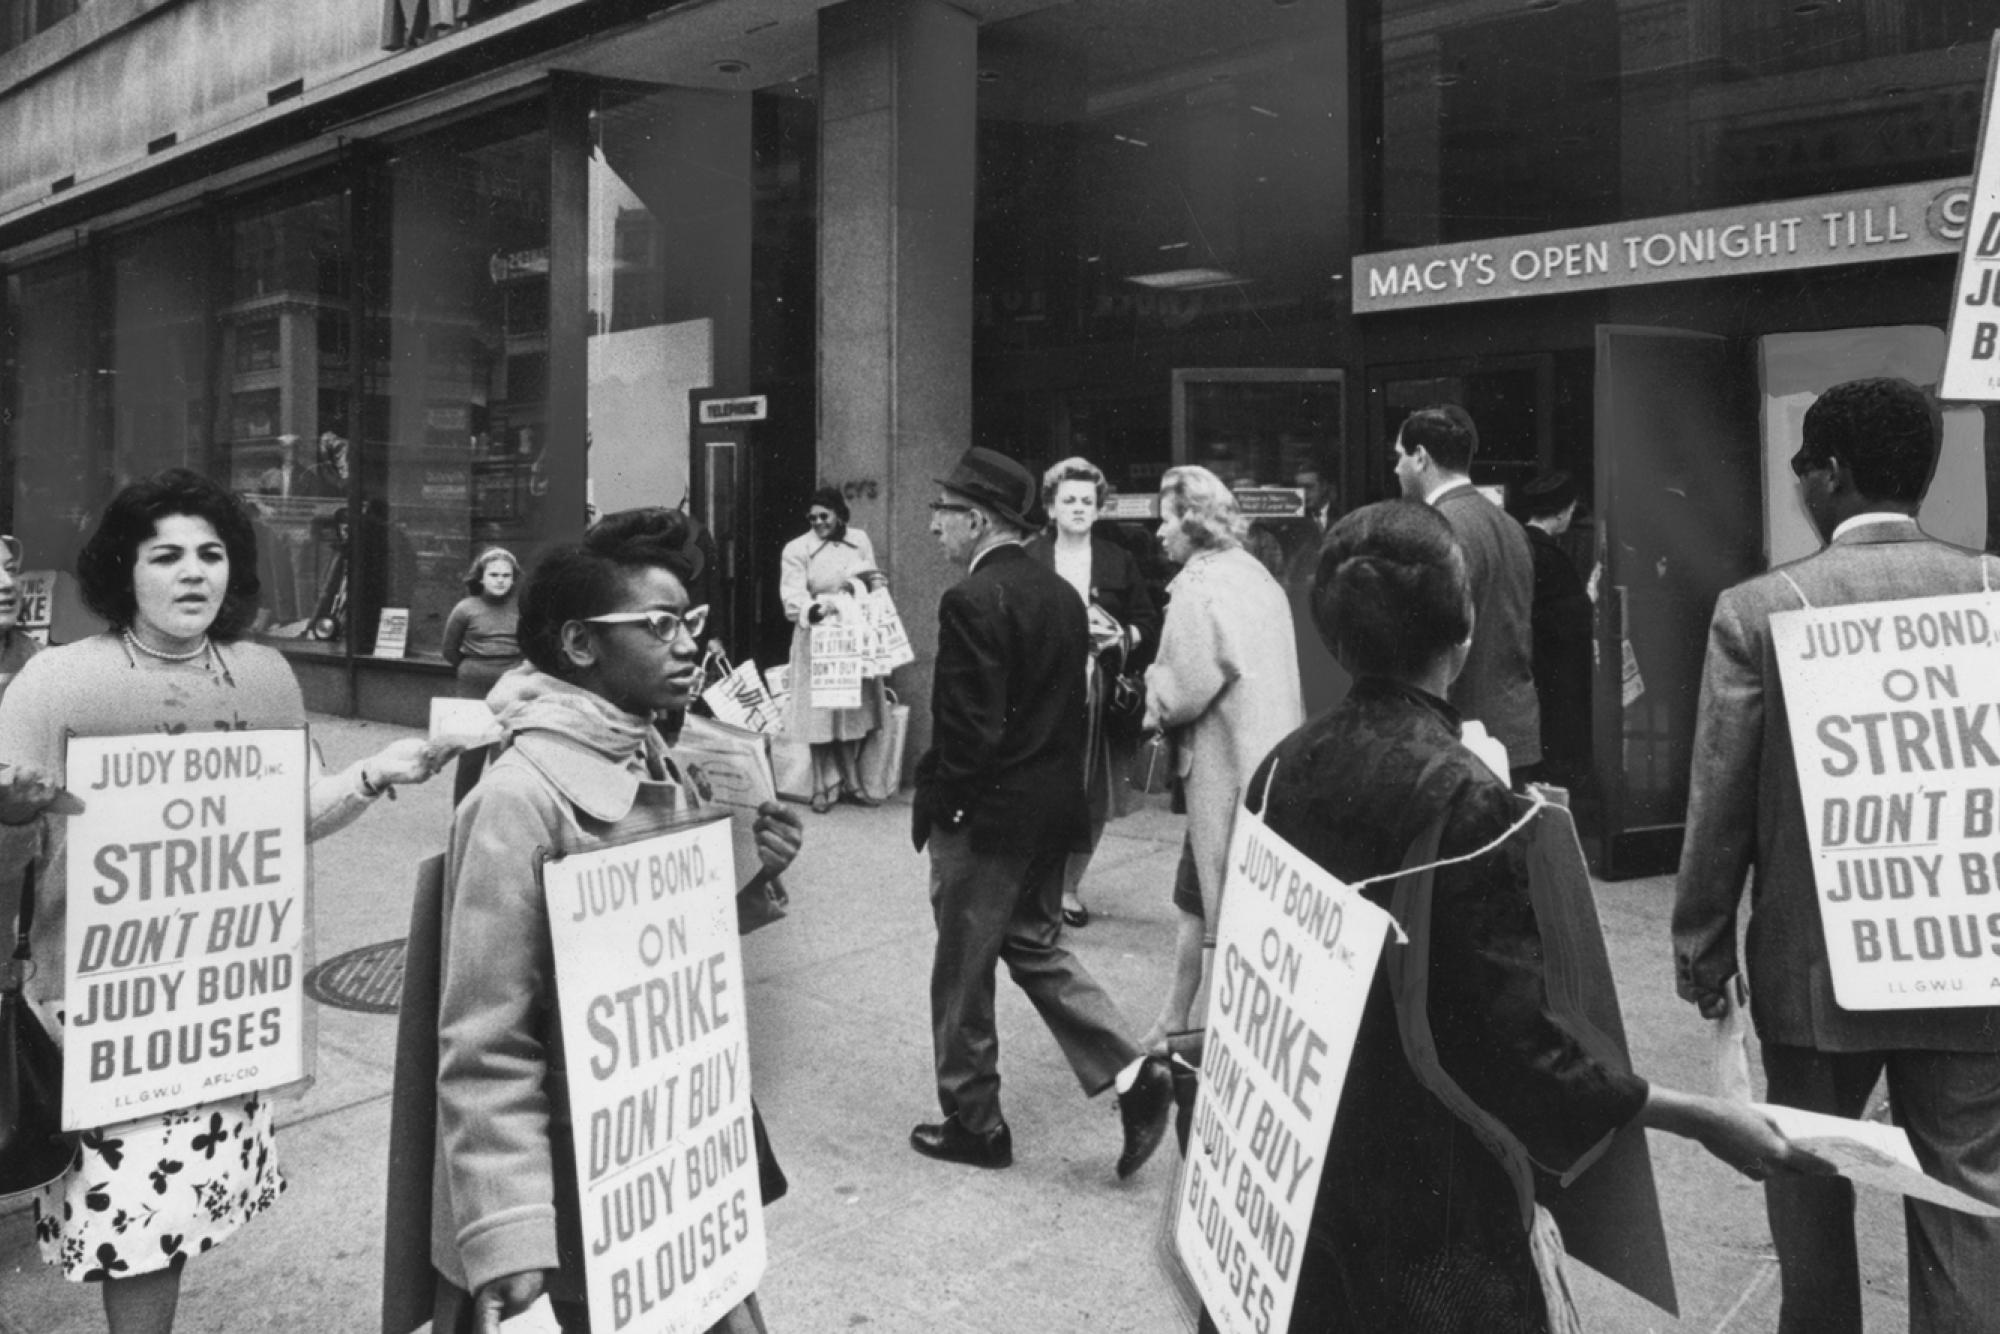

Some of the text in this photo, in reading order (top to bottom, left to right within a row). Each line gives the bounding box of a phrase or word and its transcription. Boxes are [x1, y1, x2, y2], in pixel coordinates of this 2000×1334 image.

[1370, 252, 1497, 298] MACY'S
[1510, 241, 1609, 281] OPEN
[1624, 217, 1802, 271] TONIGHT
[1822, 207, 1909, 249] TILL
[1800, 616, 1882, 660] JUDY
[1882, 664, 1959, 702] ON
[91, 749, 175, 790] JUDY
[1816, 702, 2000, 778] STRIK
[162, 795, 227, 831] ON
[1821, 783, 1947, 848] DON'T
[92, 828, 282, 906] STRIKE
[572, 858, 640, 922] JUDY
[1238, 833, 1287, 902] JUDY
[1826, 853, 1944, 903] JUDY
[76, 897, 294, 975] DON'T BUY
[638, 915, 687, 967] ON
[1261, 927, 1303, 995] ON
[73, 953, 293, 1028] JUDY BOND
[586, 951, 730, 1081] STRIKE
[90, 1007, 282, 1083] BLOUSES
[1219, 942, 1329, 1122] STRIKE
[688, 1041, 739, 1130] BUY
[591, 1115, 748, 1257] JUDY BOND
[1196, 1094, 1295, 1283] JUDY BOND
[1249, 1099, 1315, 1205] BUY
[611, 1188, 749, 1332] BLOUSES
[1188, 1159, 1275, 1334] BLOUSES
